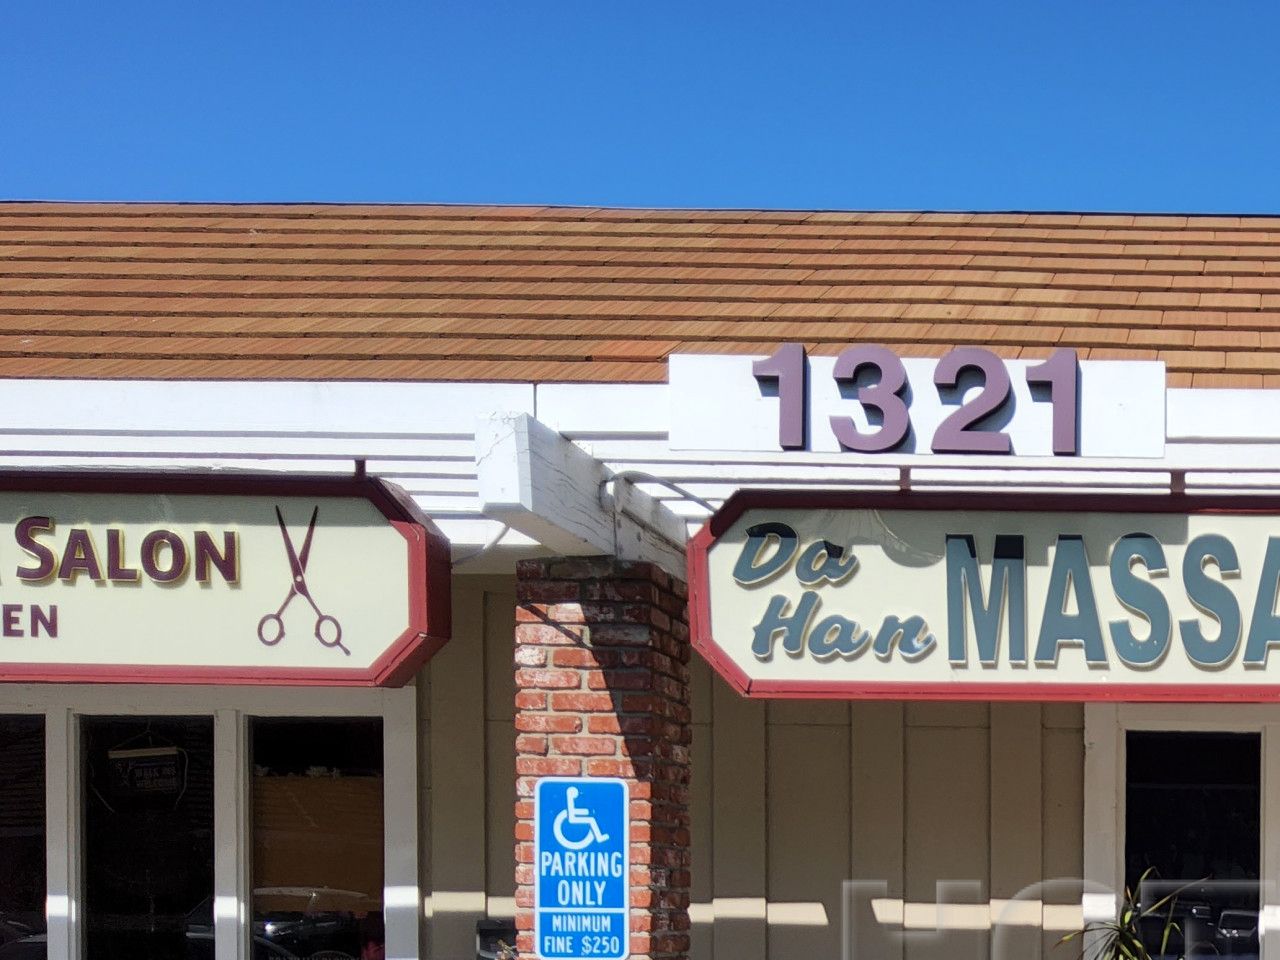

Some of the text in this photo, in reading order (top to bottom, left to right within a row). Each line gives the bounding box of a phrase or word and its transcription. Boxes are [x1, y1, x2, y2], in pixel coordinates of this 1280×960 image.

[752, 343, 1078, 456] 1321
[14, 514, 242, 585] SALON
[731, 521, 861, 587] Da
[750, 589, 938, 661] Han
[541, 851, 623, 878] PARKING
[557, 879, 607, 906] ONLY
[544, 935, 620, 955] FINE $250
[551, 914, 612, 933] MINIMUM
